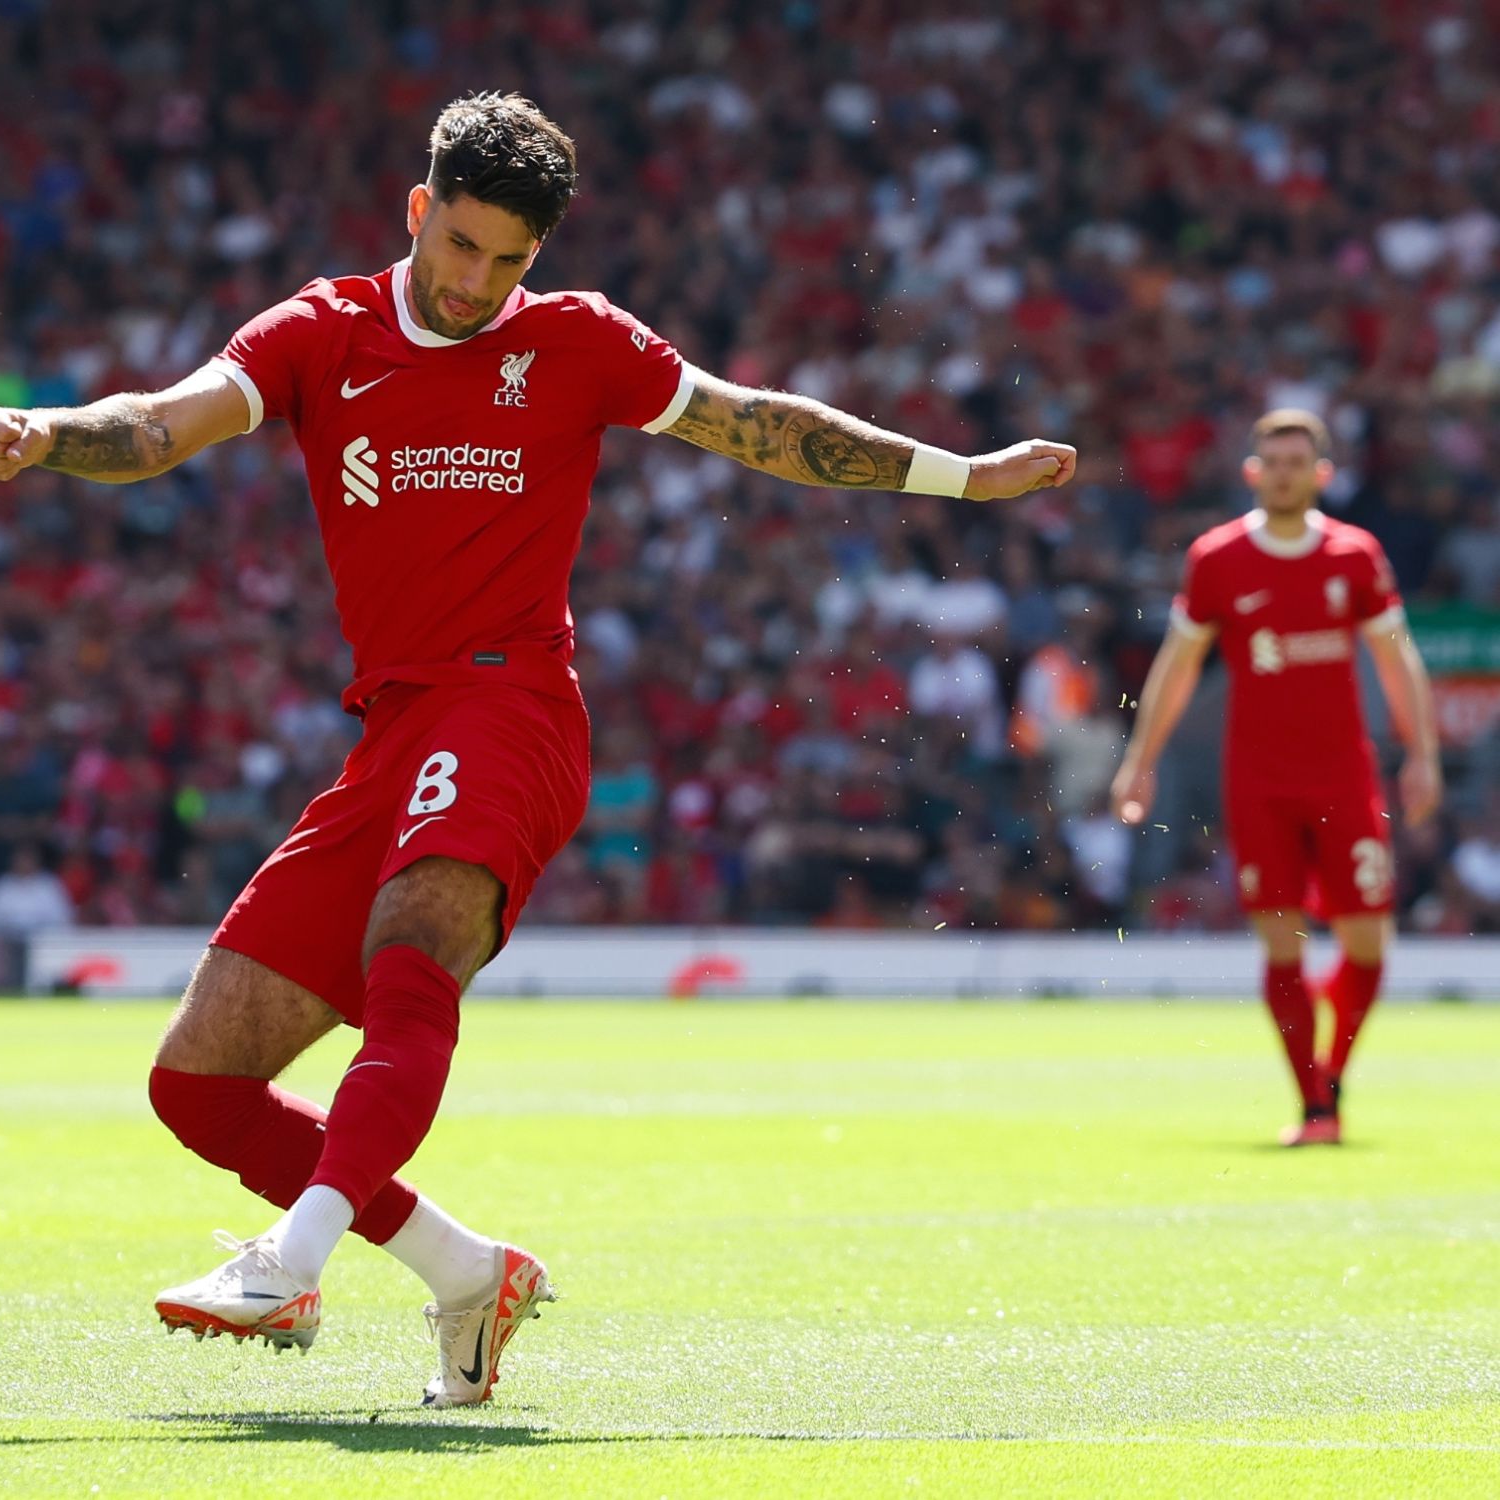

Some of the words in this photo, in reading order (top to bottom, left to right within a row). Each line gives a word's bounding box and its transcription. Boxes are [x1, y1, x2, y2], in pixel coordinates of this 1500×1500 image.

[493, 392, 529, 408] L.F.C.
[390, 442, 522, 471] standard
[391, 465, 525, 494] chartered
[407, 750, 459, 816] 8
